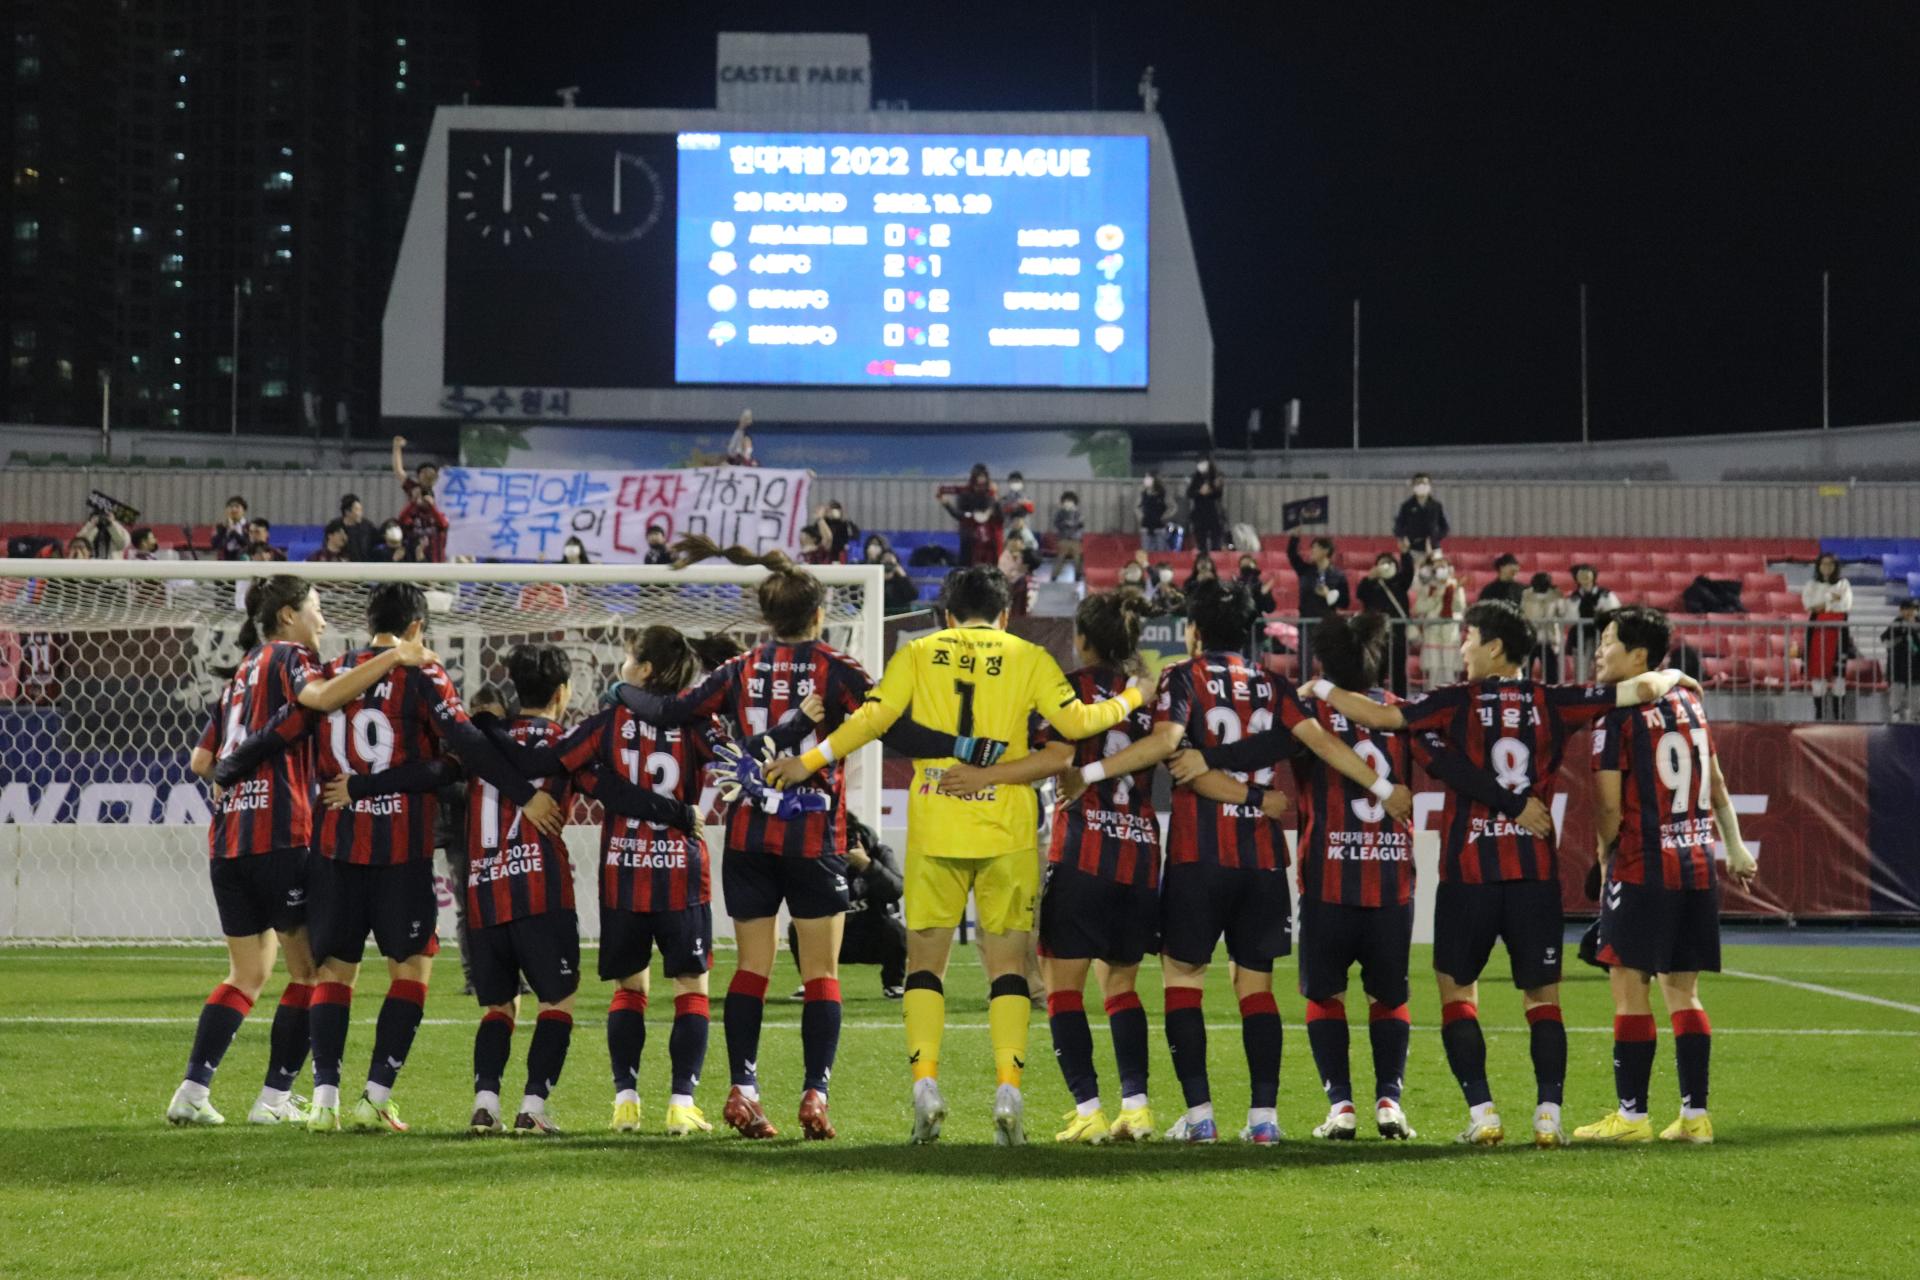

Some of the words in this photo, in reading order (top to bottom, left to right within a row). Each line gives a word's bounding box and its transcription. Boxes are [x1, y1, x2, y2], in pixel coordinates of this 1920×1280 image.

[720, 66, 799, 82] CASTLE
[807, 66, 864, 83] PARK
[831, 147, 909, 175] 2022
[928, 254, 941, 277] 1
[932, 649, 1003, 676] 조의정
[747, 677, 816, 700] 전은하
[1206, 678, 1272, 701] 이은미
[954, 678, 976, 738] 1
[328, 708, 395, 774] 19
[1491, 736, 1531, 795] 8
[1656, 727, 1712, 815] 91
[240, 778, 269, 795] 2022
[650, 839, 685, 854] 2022
[1328, 831, 1374, 846] 현대제철
[1376, 832, 1407, 847] 2022
[505, 842, 541, 862] 2022
